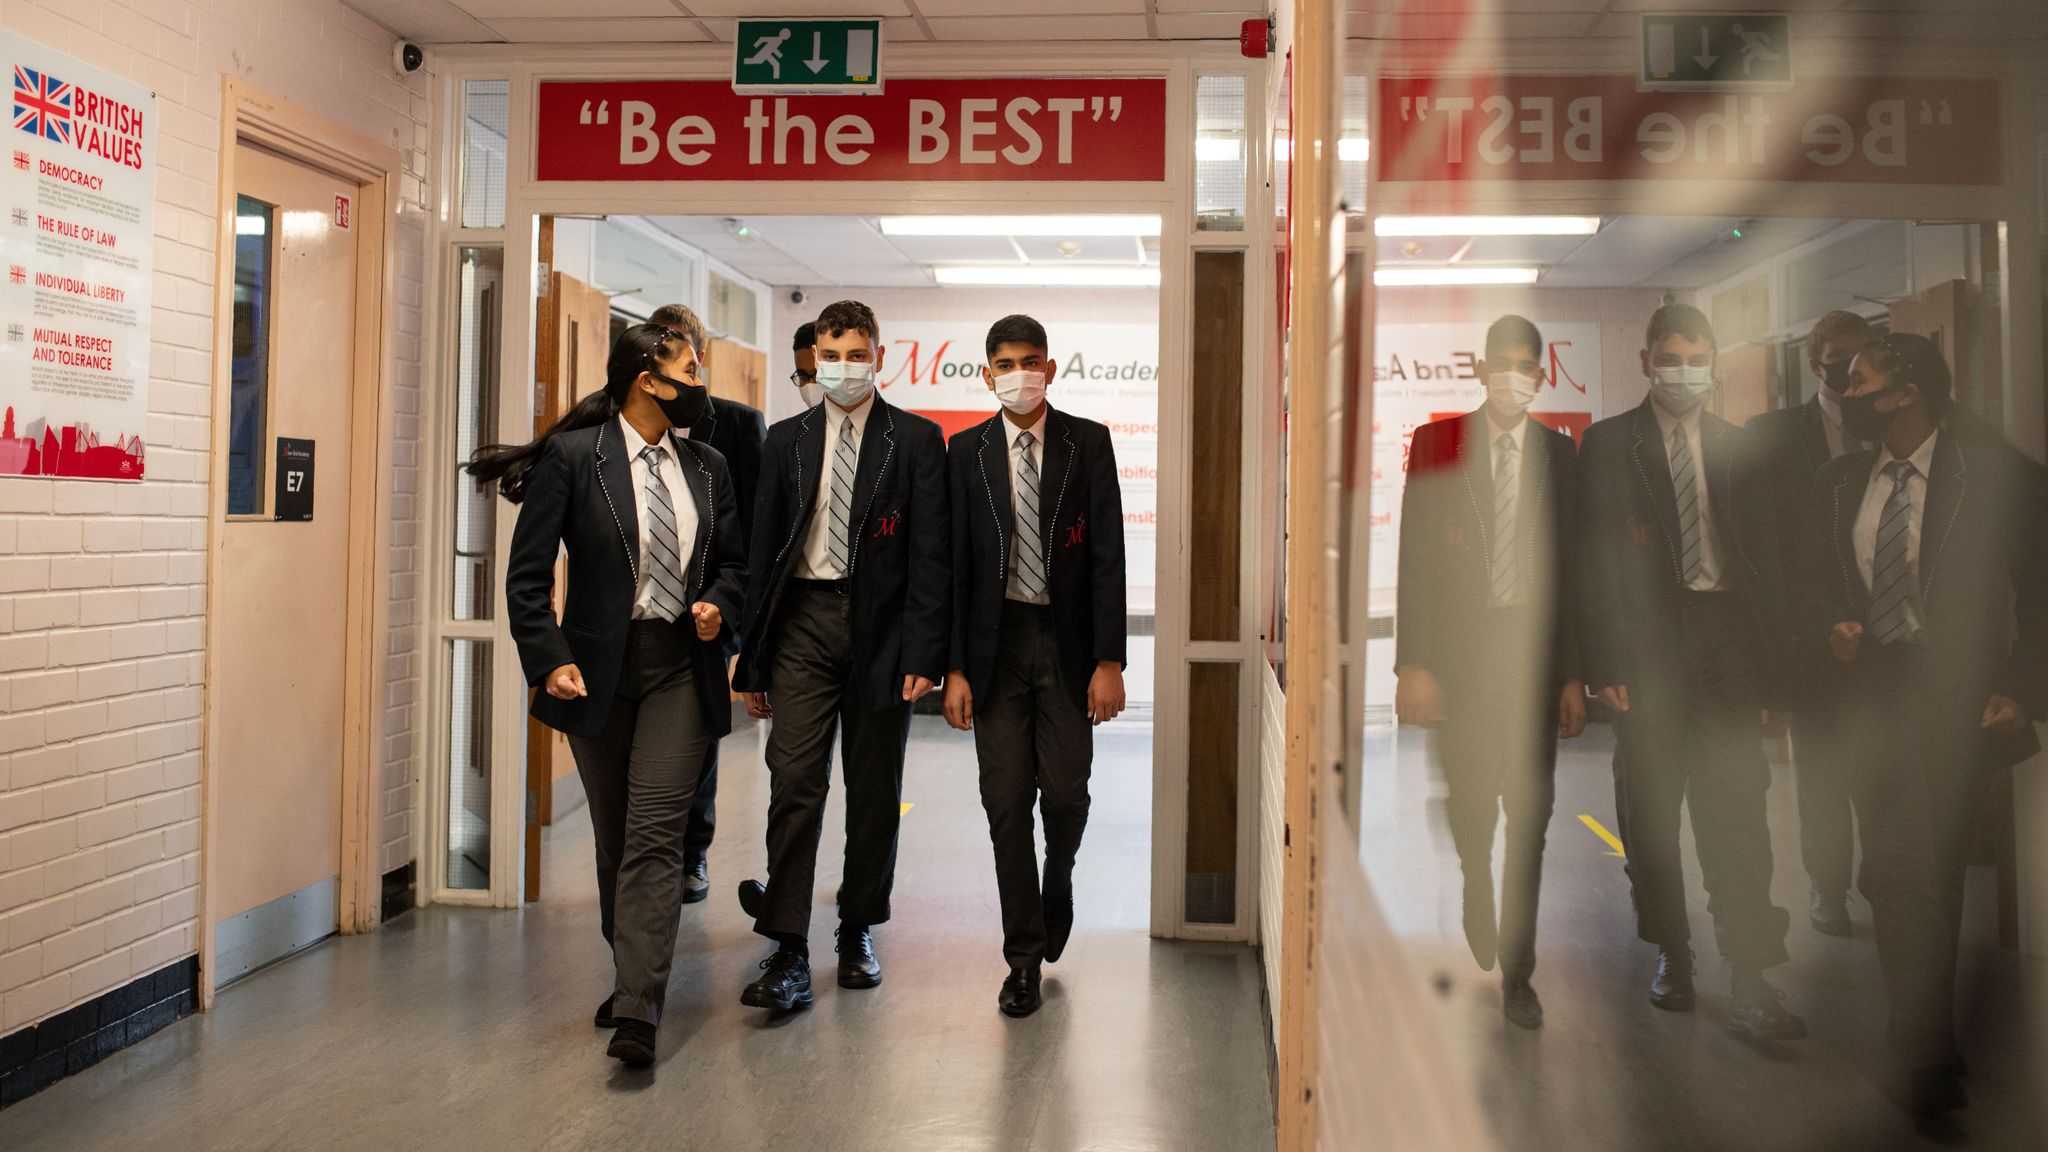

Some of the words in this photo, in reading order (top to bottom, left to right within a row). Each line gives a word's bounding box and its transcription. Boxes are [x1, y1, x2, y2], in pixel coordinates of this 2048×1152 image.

[74, 86, 143, 139] BRITISH
[74, 120, 143, 170] VALUES
[579, 98, 716, 167] “Be
[743, 97, 875, 166] the
[908, 96, 1123, 166] BEST”
[40, 159, 103, 191] DEMOCRACY
[37, 215, 54, 232] THE
[57, 220, 79, 239] RULE
[81, 227, 95, 242] OF
[97, 230, 116, 248] LAW
[35, 272, 91, 296] INDIVIDUAL
[93, 284, 125, 303] LIBERTY
[33, 328, 73, 347] MUTUAL
[75, 334, 112, 353] RESPECT
[33, 347, 56, 362] AND
[58, 350, 112, 371] TOLERANCE
[287, 470, 304, 492] E7
[873, 516, 895, 539] M
[1064, 525, 1085, 549] M
